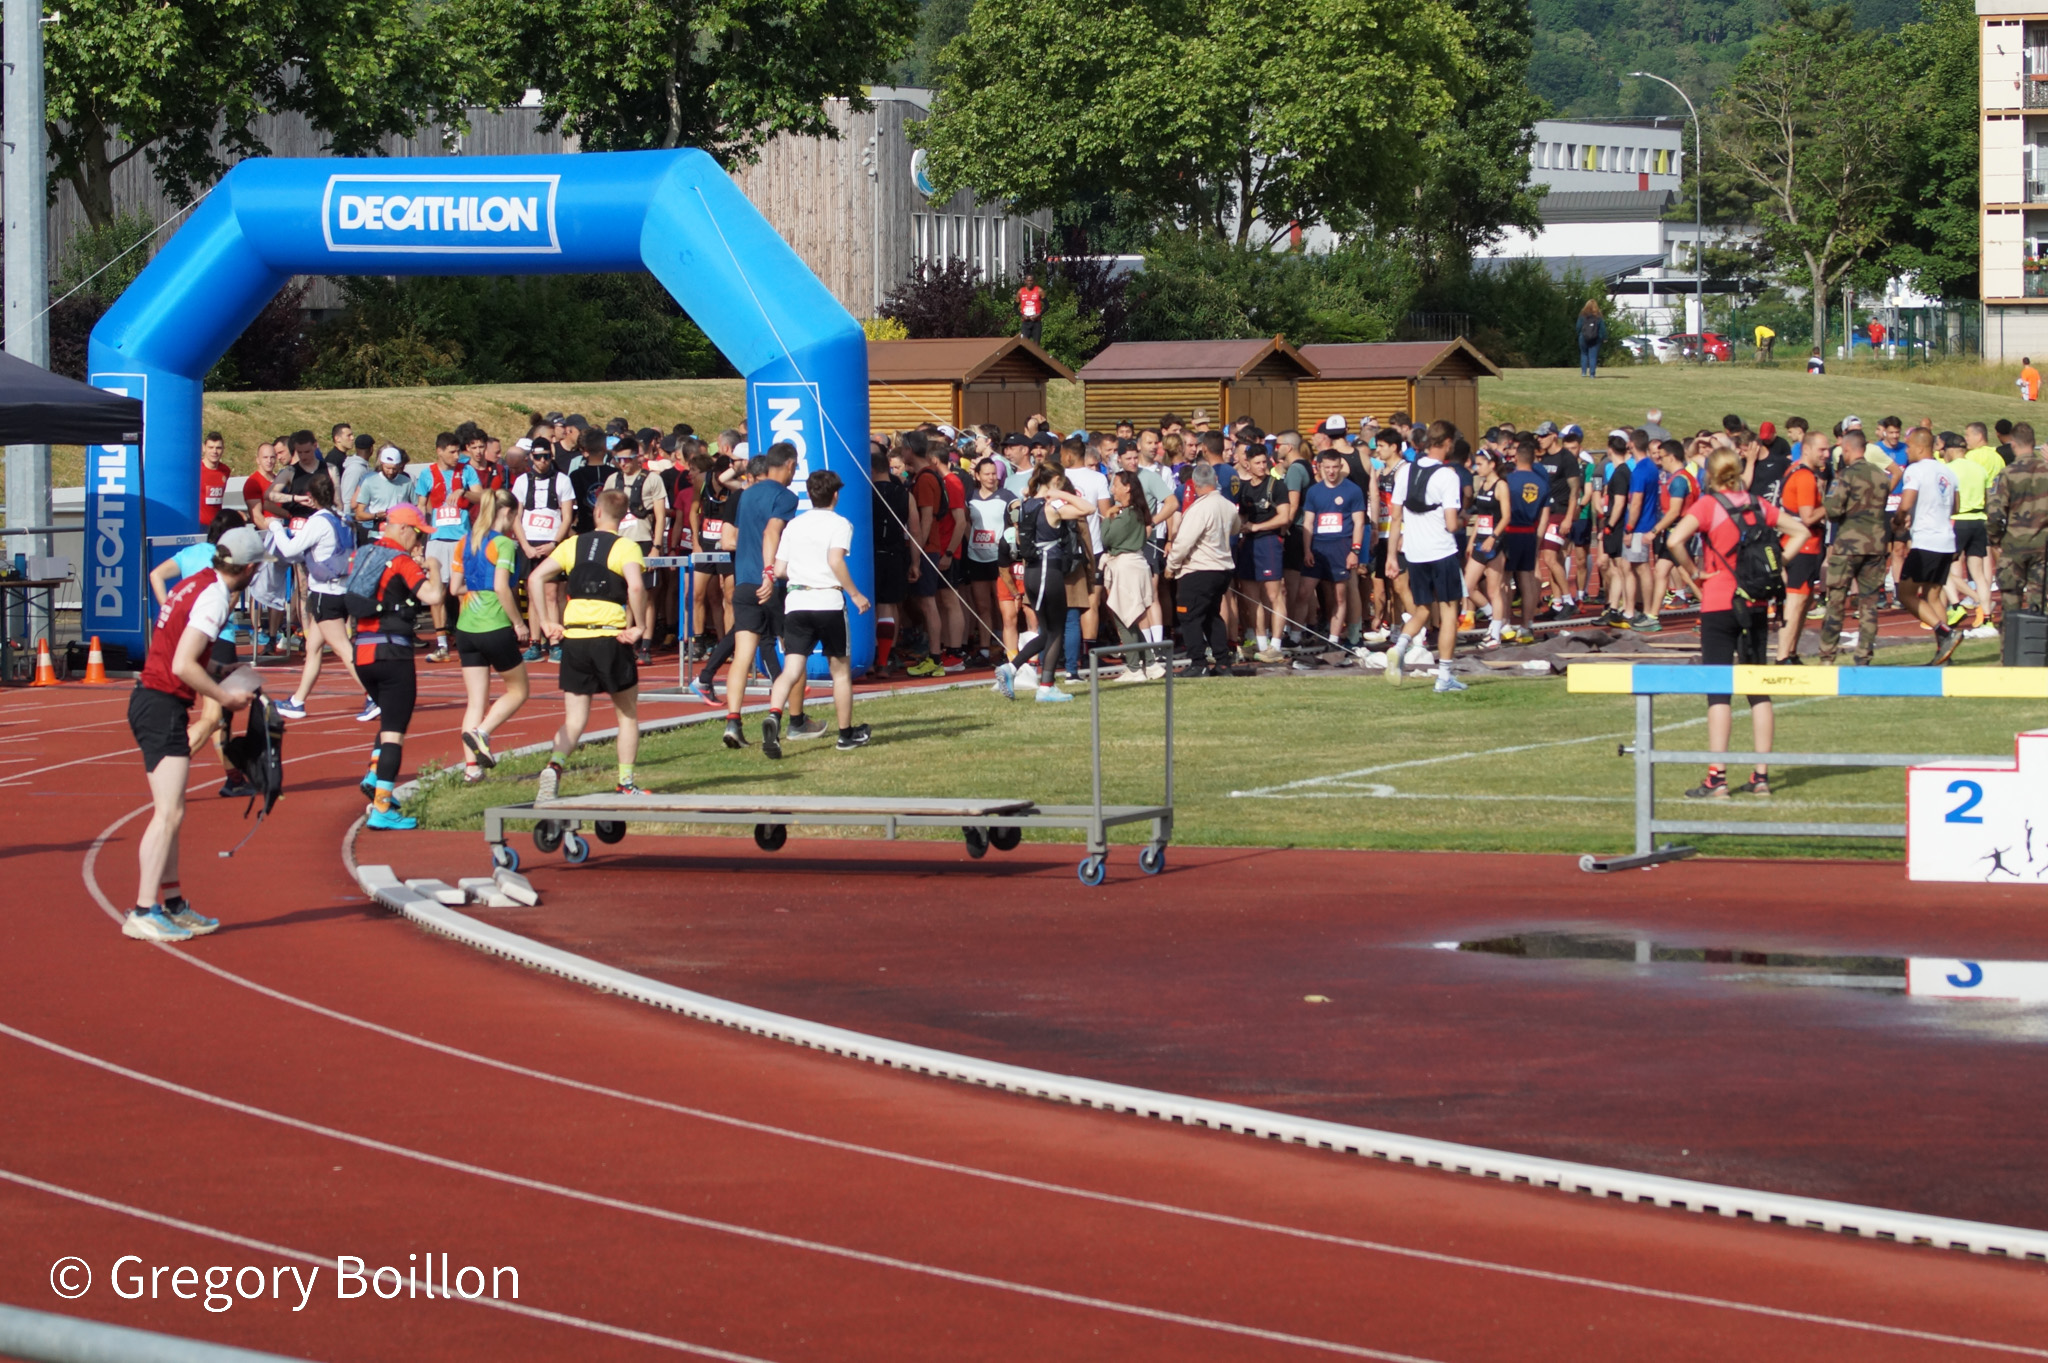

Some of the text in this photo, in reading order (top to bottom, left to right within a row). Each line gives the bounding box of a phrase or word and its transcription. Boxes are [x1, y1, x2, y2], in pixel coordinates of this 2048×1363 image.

[339, 195, 538, 232] DECATHLON
[95, 388, 130, 617] DECATHL
[440, 508, 457, 517] 119
[532, 517, 551, 527] 679
[1321, 515, 1339, 525] 272
[1945, 780, 1983, 824] 2
